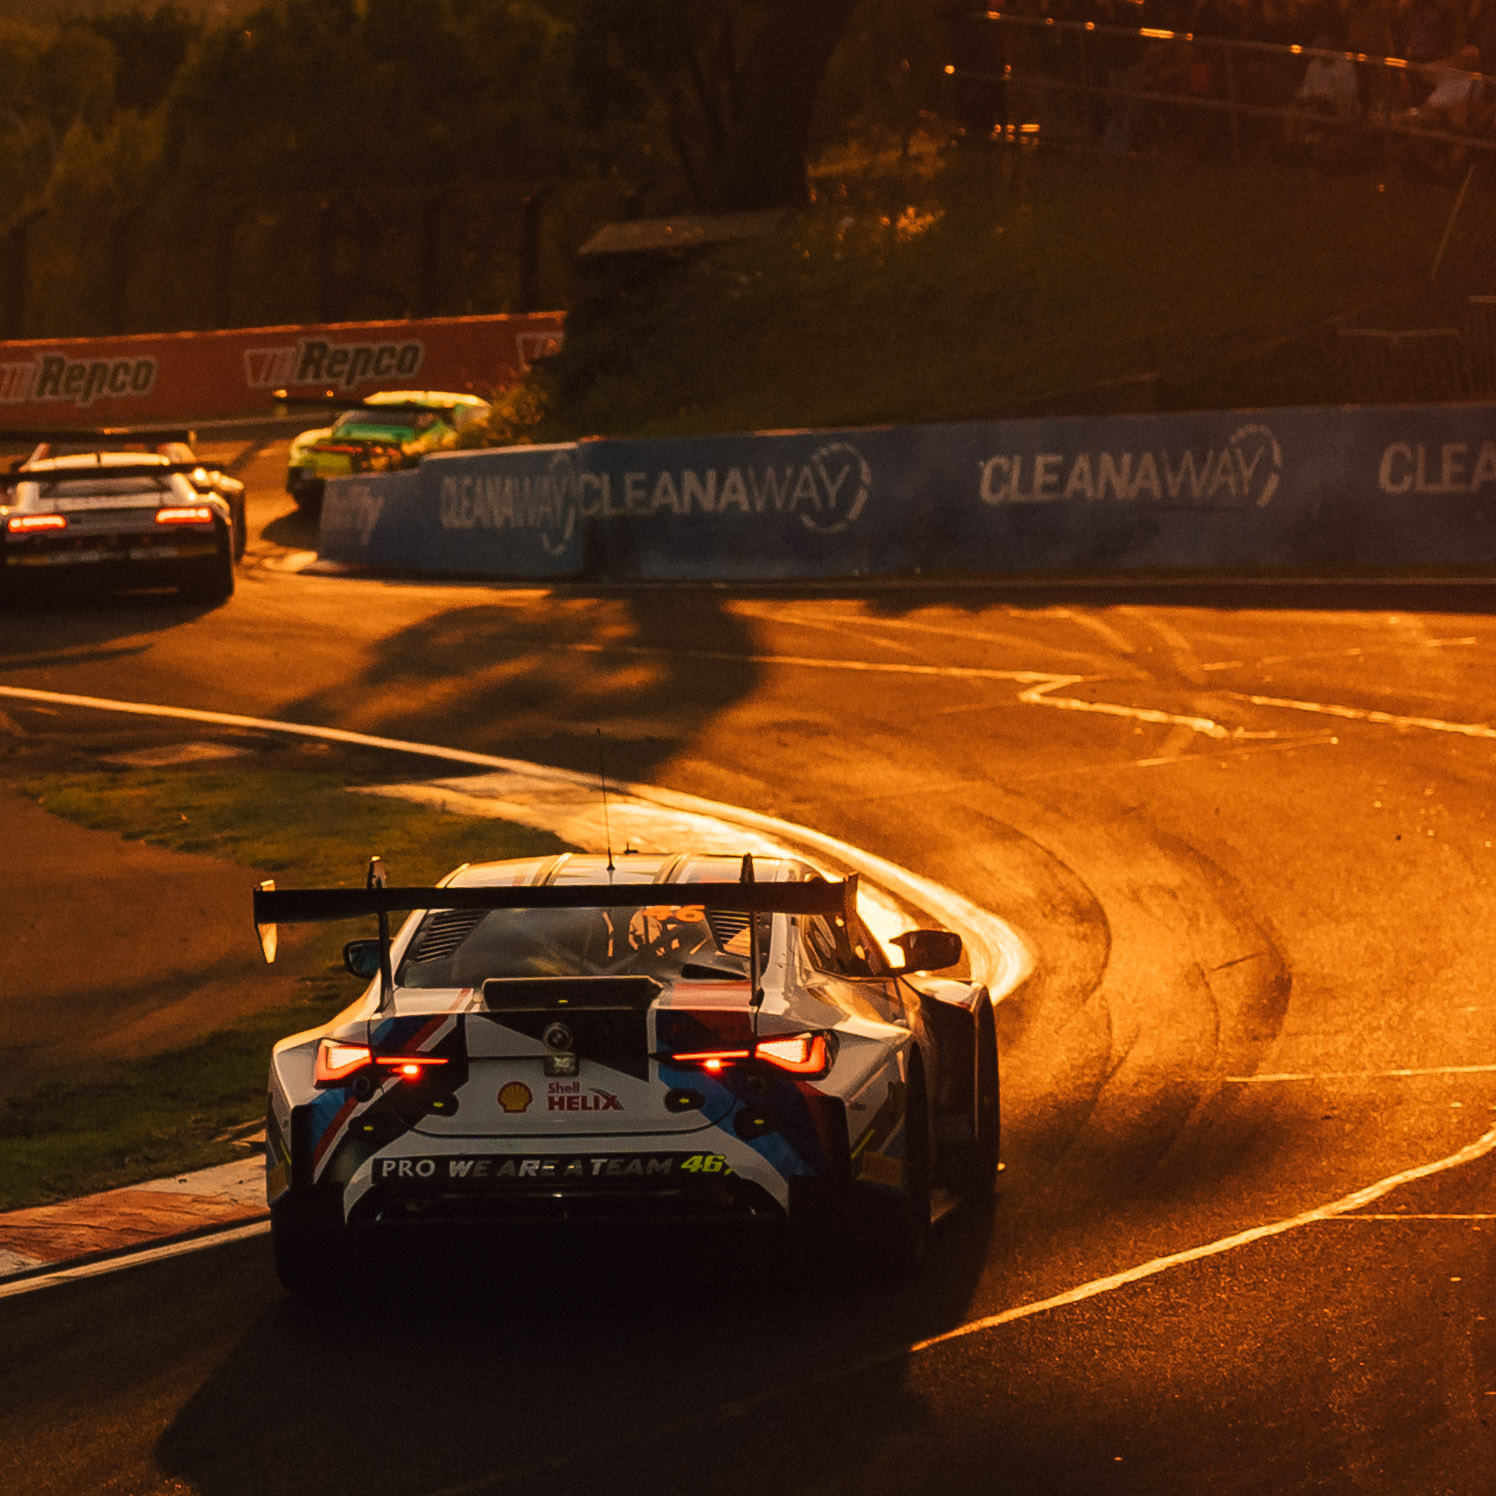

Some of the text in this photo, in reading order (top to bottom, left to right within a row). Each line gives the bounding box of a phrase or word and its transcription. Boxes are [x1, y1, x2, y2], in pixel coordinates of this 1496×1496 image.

[35, 355, 155, 403] Repco
[297, 341, 421, 386] Repco
[578, 464, 851, 517] CLEANAWAY
[980, 447, 1266, 503] CLEANAWAY
[548, 1081, 581, 1094] Shell
[548, 1094, 623, 1111] HELIX
[382, 1159, 435, 1177] PRO
[449, 1159, 492, 1177] WE
[496, 1159, 559, 1177] ARE
[563, 1159, 583, 1176] A
[590, 1158, 673, 1176] TEAM
